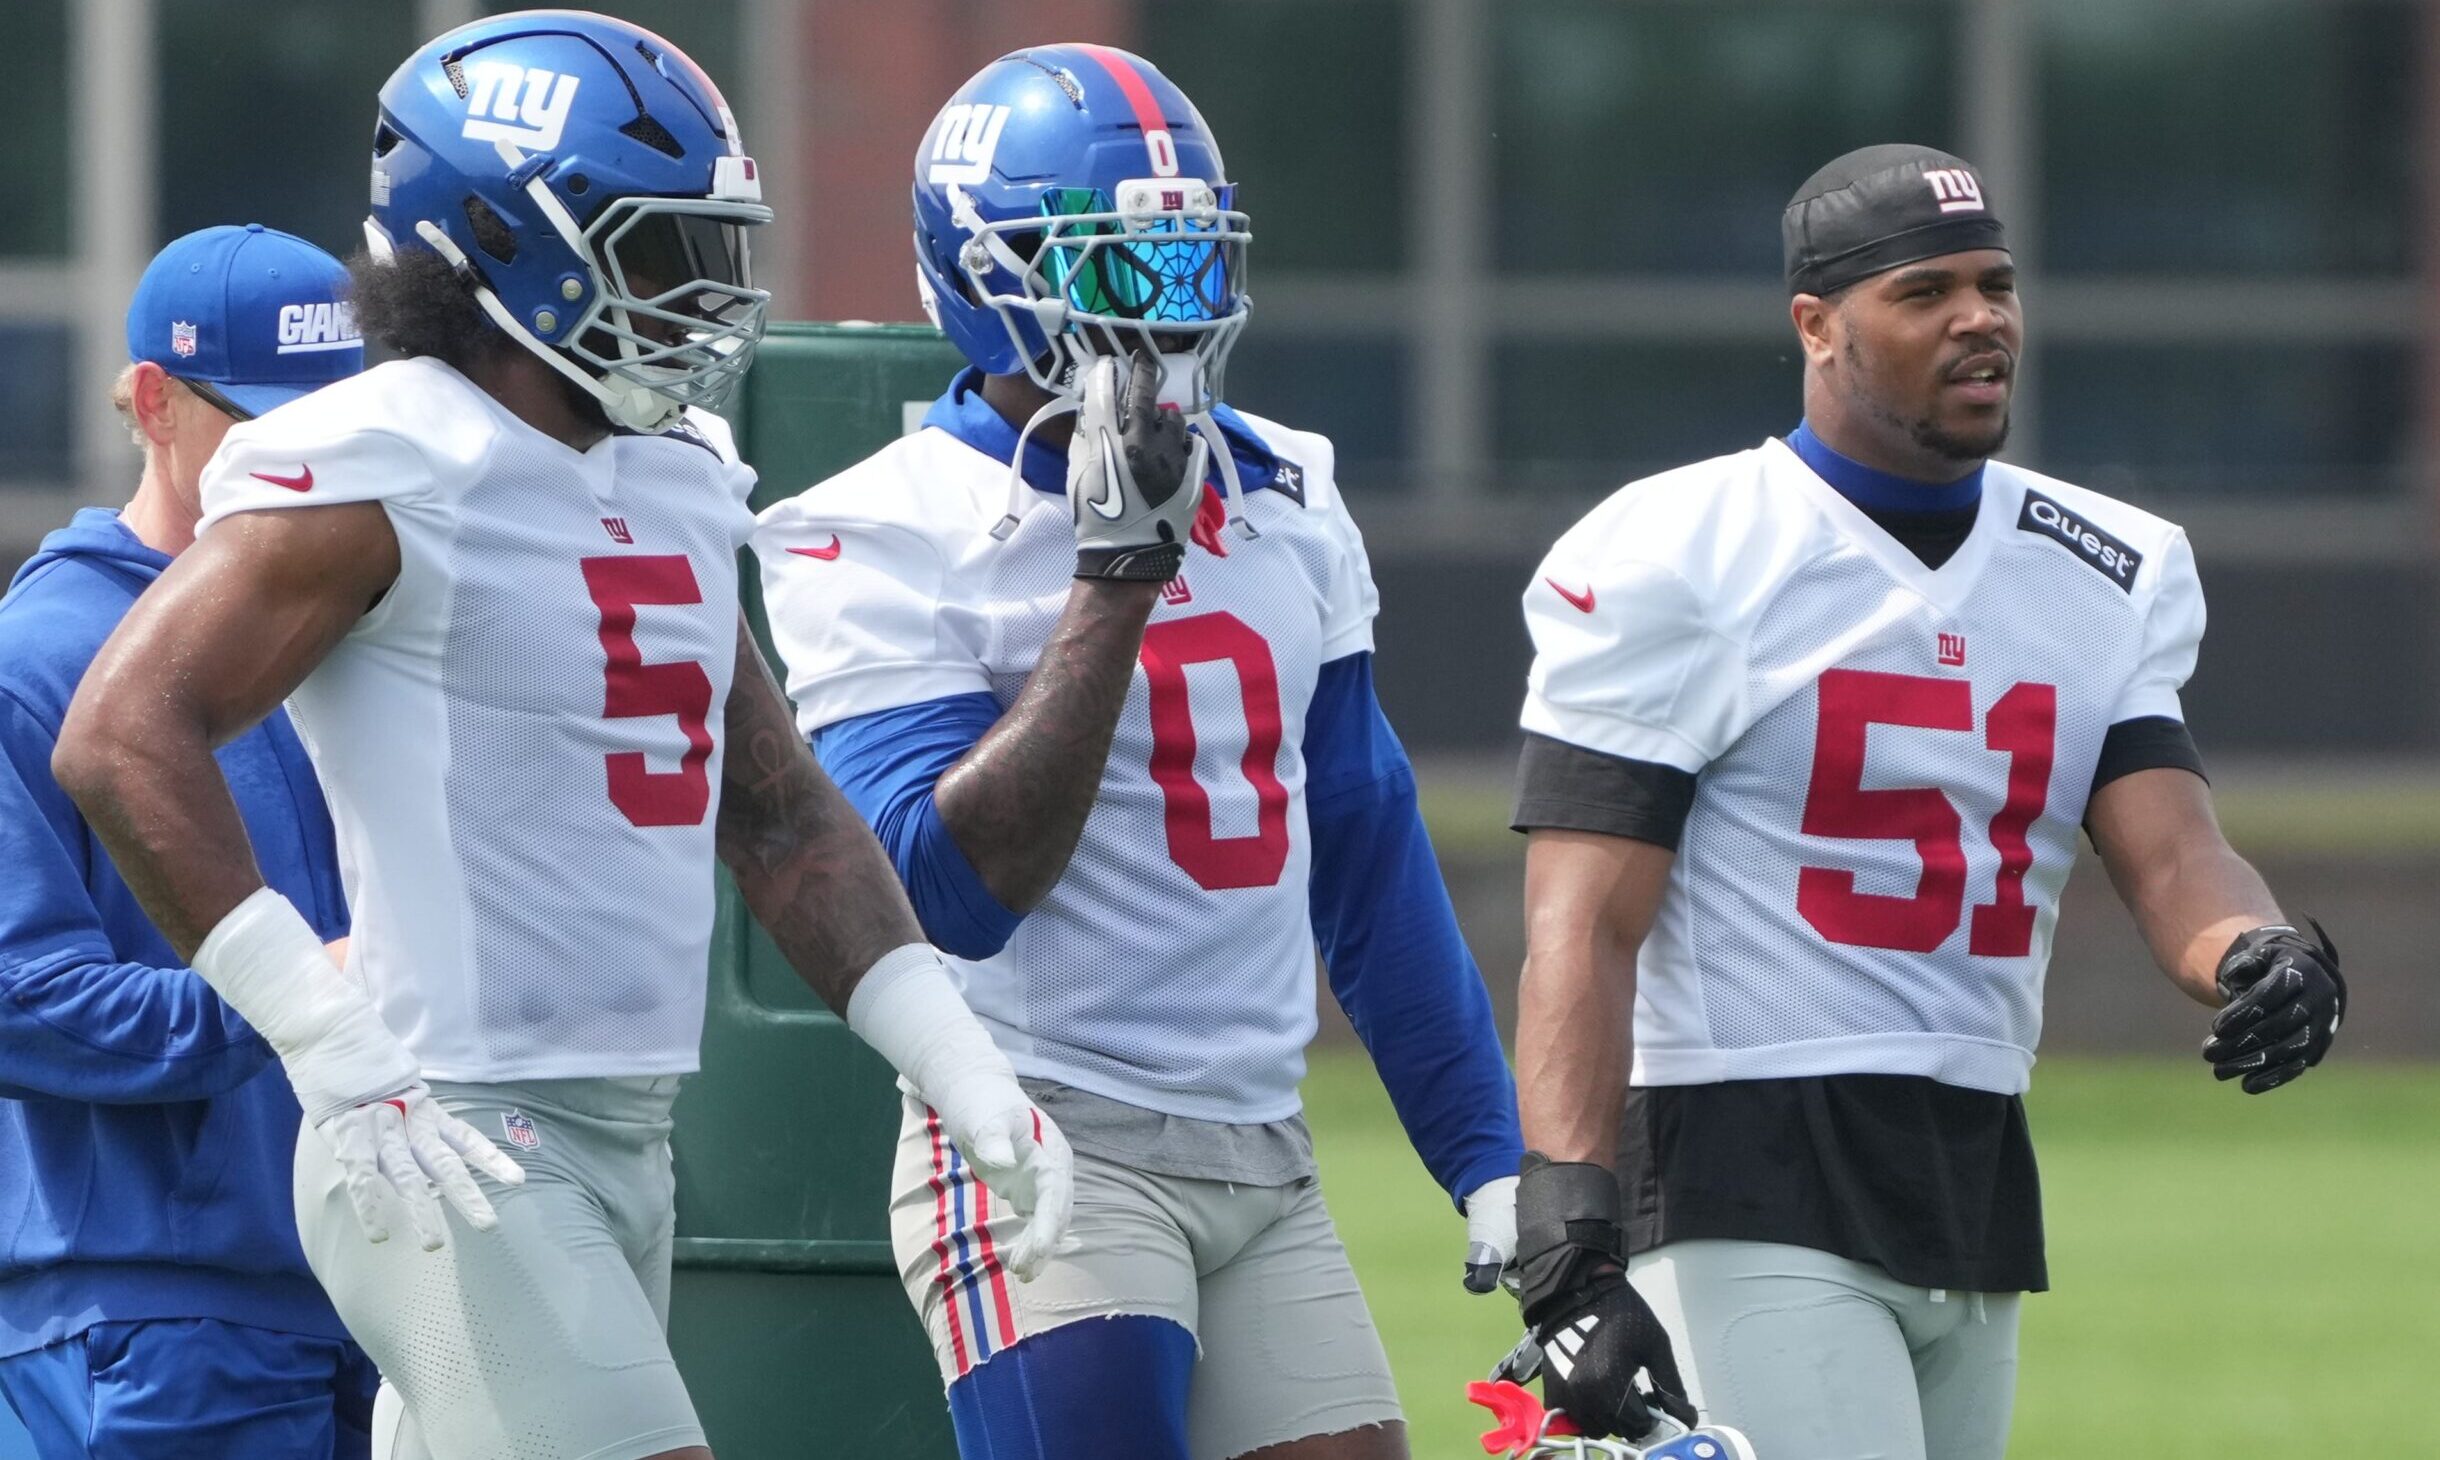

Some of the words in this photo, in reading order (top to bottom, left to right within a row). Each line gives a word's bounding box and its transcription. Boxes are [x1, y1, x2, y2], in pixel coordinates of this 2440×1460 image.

[278, 301, 361, 344] GIAN
[2029, 500, 2134, 578] Quest
[579, 554, 714, 827] 5
[1138, 610, 1289, 891] 0
[1796, 668, 2056, 957] 51
